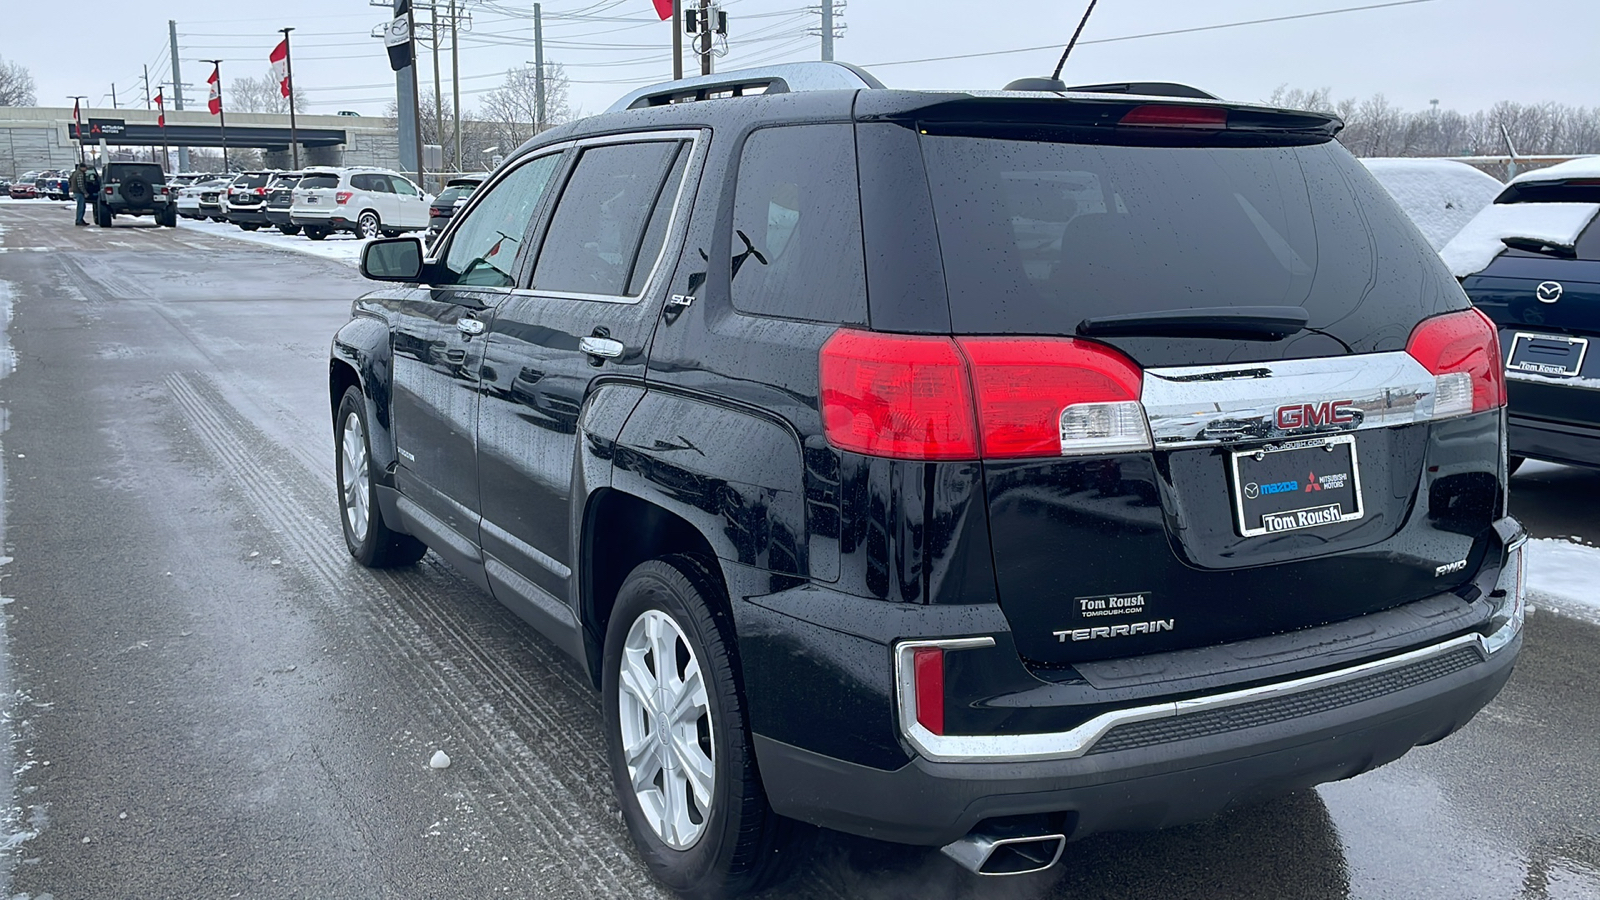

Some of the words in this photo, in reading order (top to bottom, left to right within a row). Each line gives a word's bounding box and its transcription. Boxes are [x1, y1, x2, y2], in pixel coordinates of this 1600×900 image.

[671, 294, 696, 306] SLT
[1521, 362, 1538, 371] Tom
[1277, 400, 1354, 429] GMC
[1261, 481, 1298, 494] mazda
[1319, 473, 1347, 483] MITSUBISHI
[1324, 481, 1344, 489] MOTORS
[1265, 516, 1297, 532] Tom
[1297, 506, 1340, 526] Roush
[1080, 599, 1105, 610] Tom
[1109, 595, 1145, 608] Roush
[1082, 607, 1142, 618] TOMROUSH.COM
[1053, 619, 1174, 642] TERRAIN
